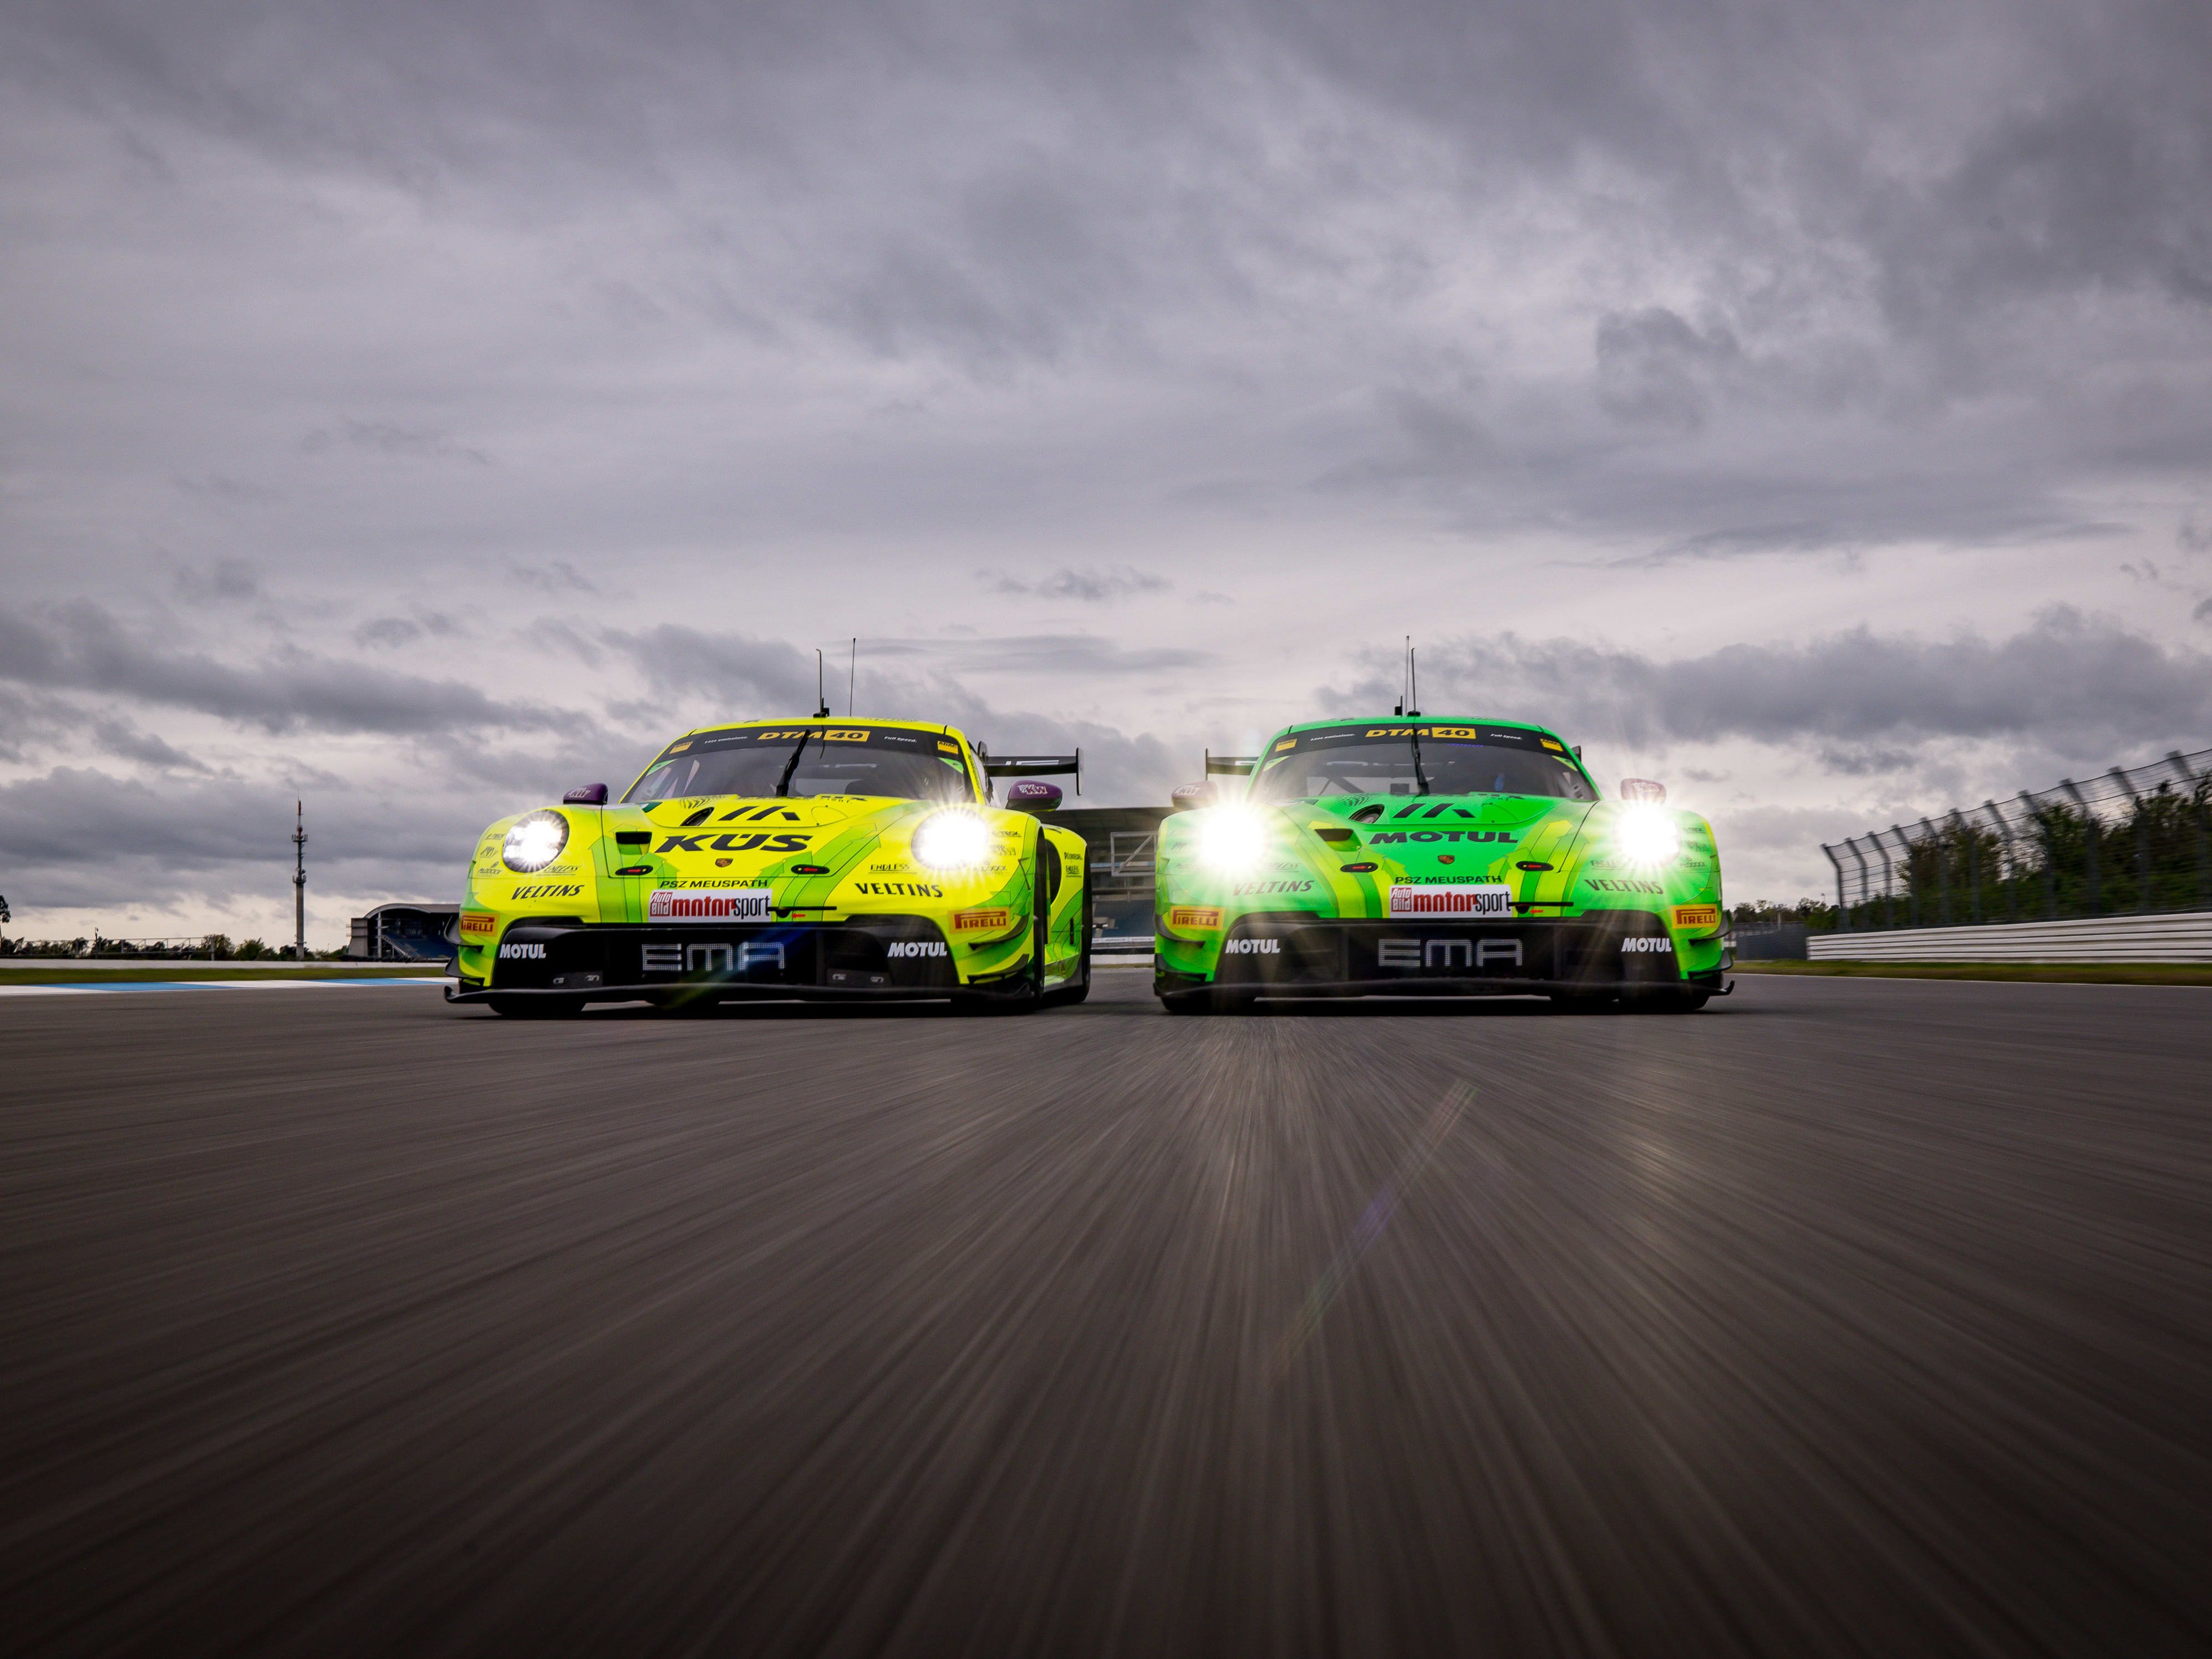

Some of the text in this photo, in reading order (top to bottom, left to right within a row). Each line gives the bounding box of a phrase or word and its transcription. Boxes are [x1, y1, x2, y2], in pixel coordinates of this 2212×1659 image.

[757, 731, 823, 740] DTM
[1365, 729, 1430, 737] DTM
[654, 833, 813, 853] KÜS
[1369, 831, 1519, 845] MOTUL
[689, 879, 768, 888] MEUSPATH
[1425, 875, 1502, 883] MEUSPATH
[1584, 879, 1664, 894] VELTINS
[511, 884, 585, 900] VELTINS
[855, 883, 943, 898] VELTINS
[1233, 879, 1315, 896] VELTINS
[1392, 888, 1411, 897] Auto
[651, 892, 670, 903] Auto
[461, 915, 495, 932] PIRELLI
[954, 910, 1006, 929] PIRELLI
[1173, 909, 1219, 927] PIRELLI
[1676, 908, 1716, 925] PIRELLI
[500, 944, 547, 959] MOTUL
[887, 942, 948, 958] MOTUL
[1225, 938, 1281, 954] MOTUL
[1379, 938, 1523, 967] EMA
[1621, 937, 1672, 953] MOTUL
[641, 942, 785, 971] EMA
